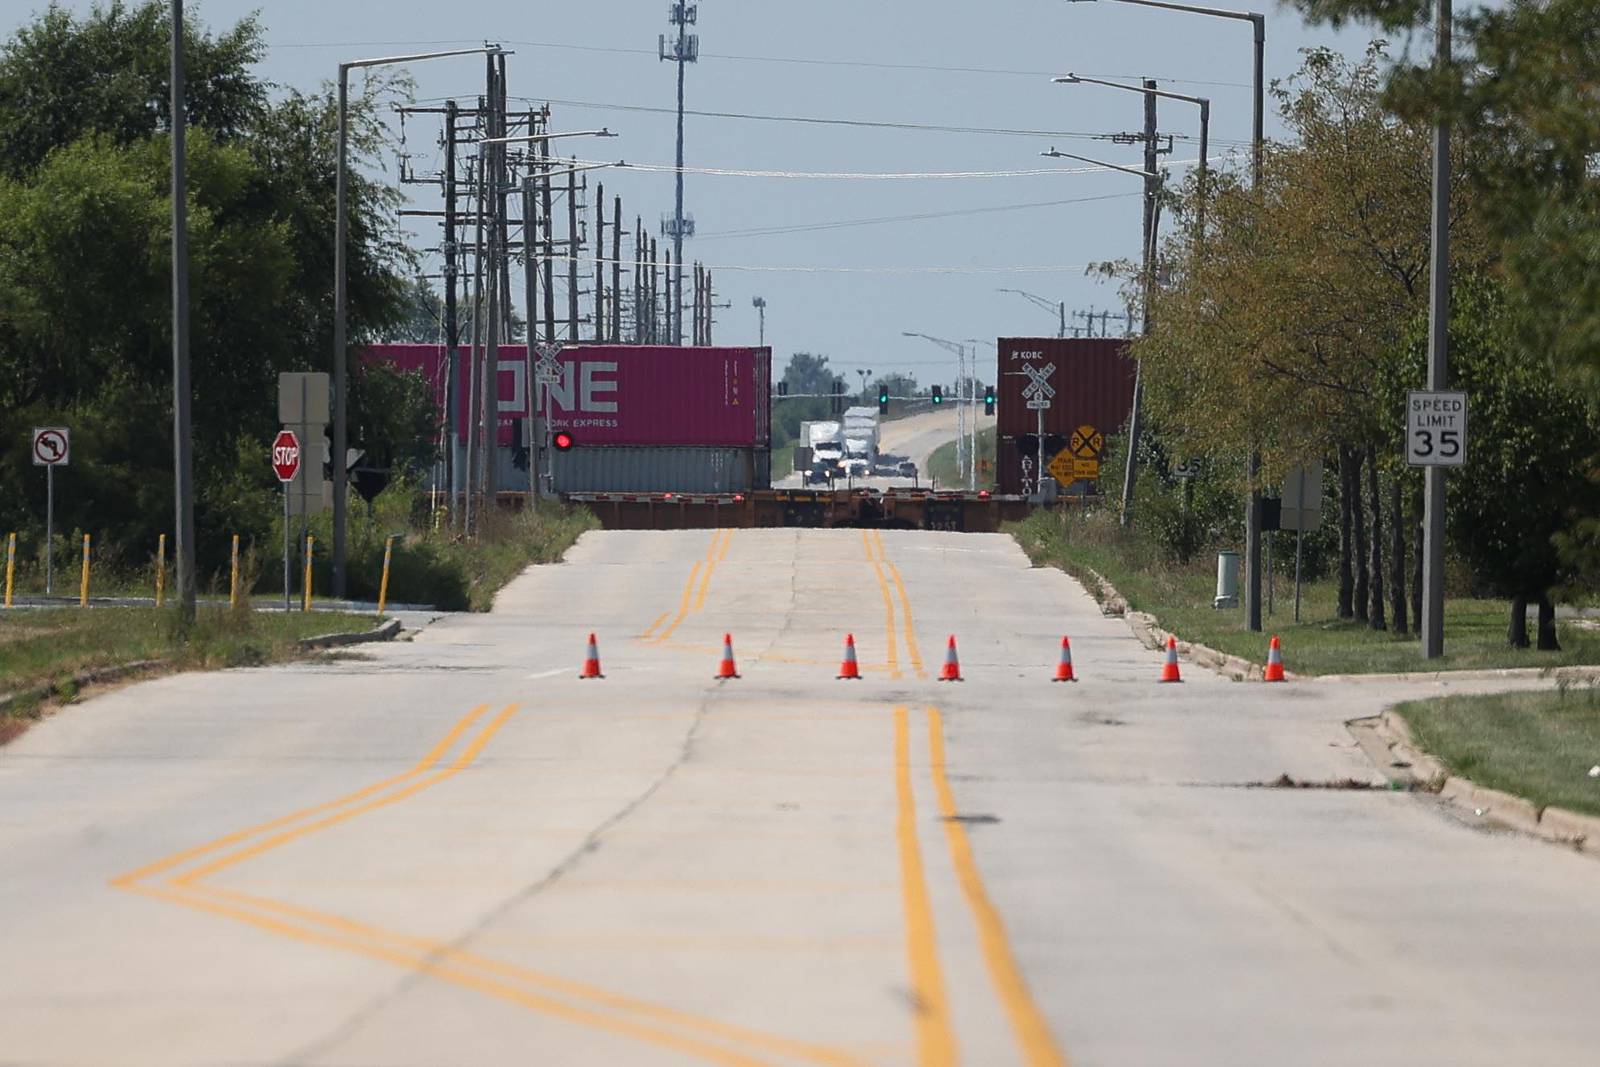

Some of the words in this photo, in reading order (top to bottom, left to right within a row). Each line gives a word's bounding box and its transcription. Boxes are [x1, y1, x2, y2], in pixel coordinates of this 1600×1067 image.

[1412, 399, 1462, 412] SPEED
[573, 419, 618, 427] EXPRESS
[1417, 415, 1456, 427] LIMIT
[1072, 437, 1080, 446] R
[1093, 438, 1100, 446] R
[1414, 430, 1460, 457] 35
[275, 446, 298, 466] STOP
